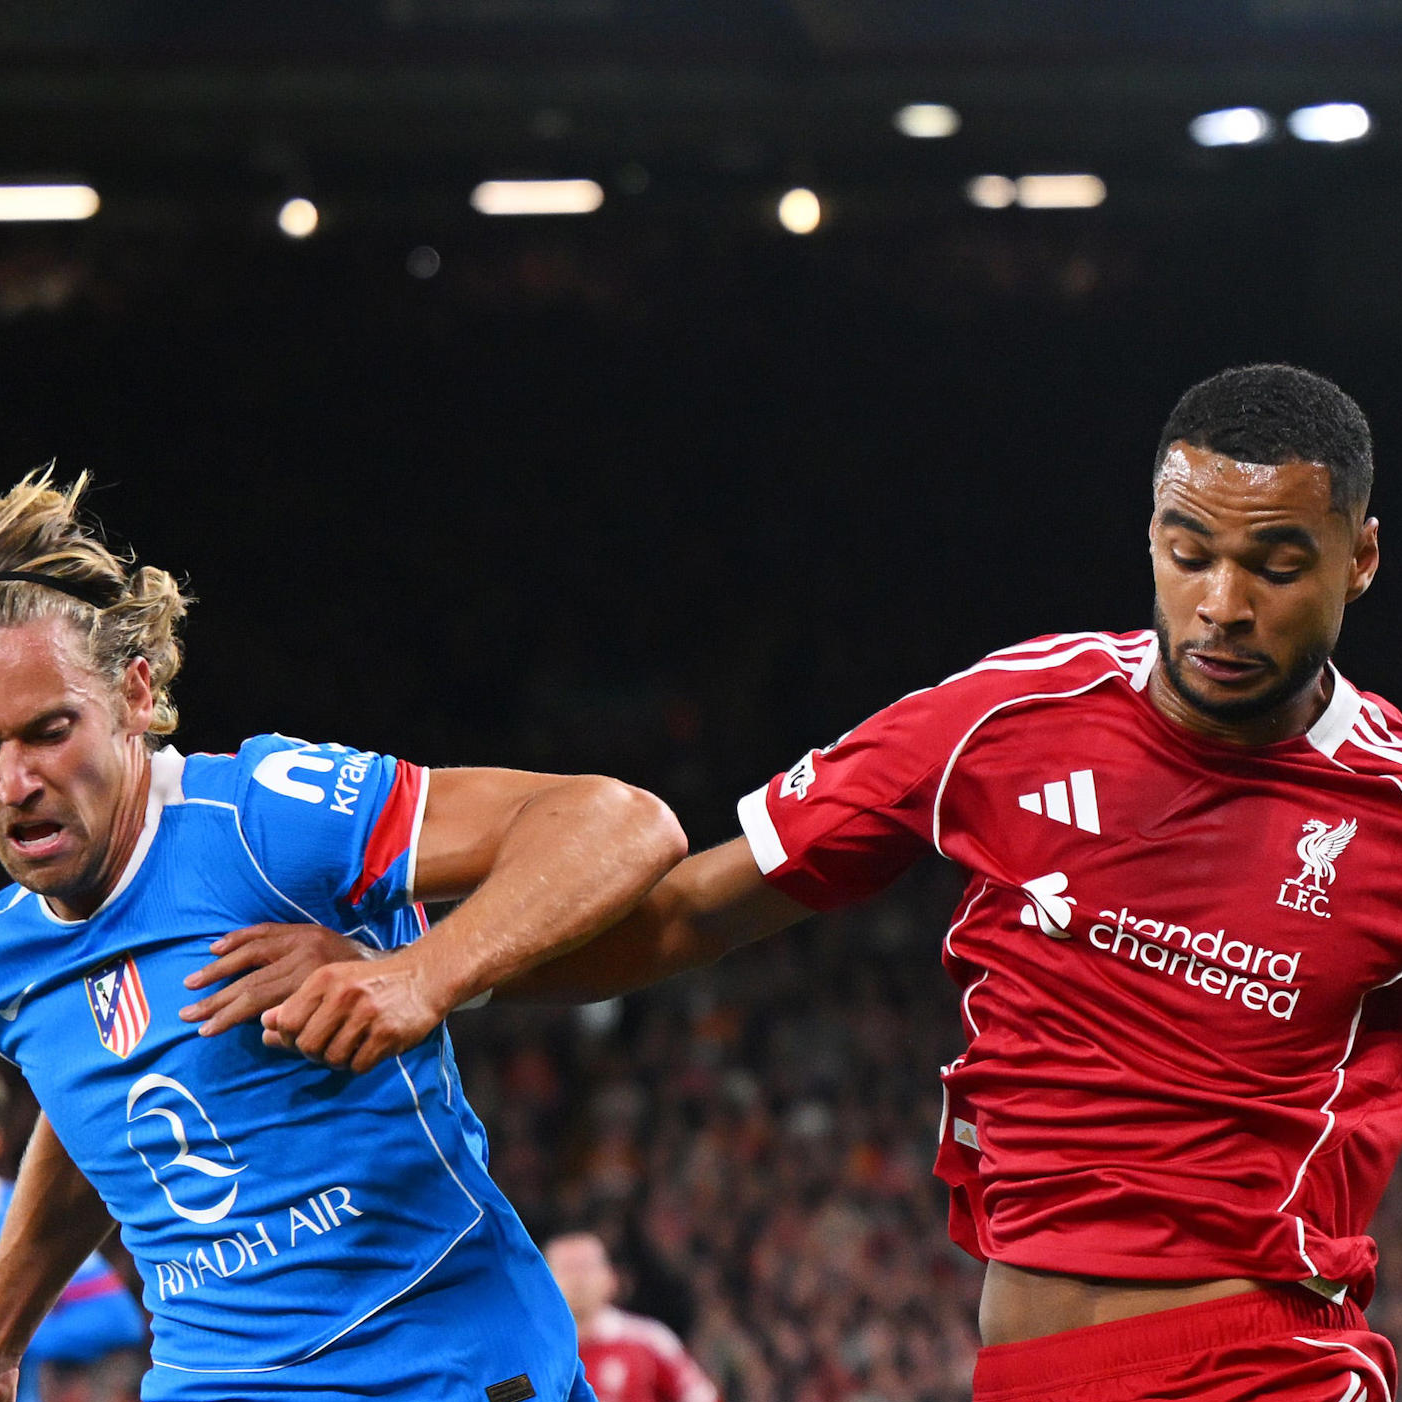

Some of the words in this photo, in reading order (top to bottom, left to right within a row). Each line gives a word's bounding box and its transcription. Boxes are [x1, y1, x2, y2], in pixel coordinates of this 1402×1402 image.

[1088, 923, 1301, 1020] chartered
[155, 1222, 279, 1301] RIYADH
[289, 1186, 364, 1248] AIR
